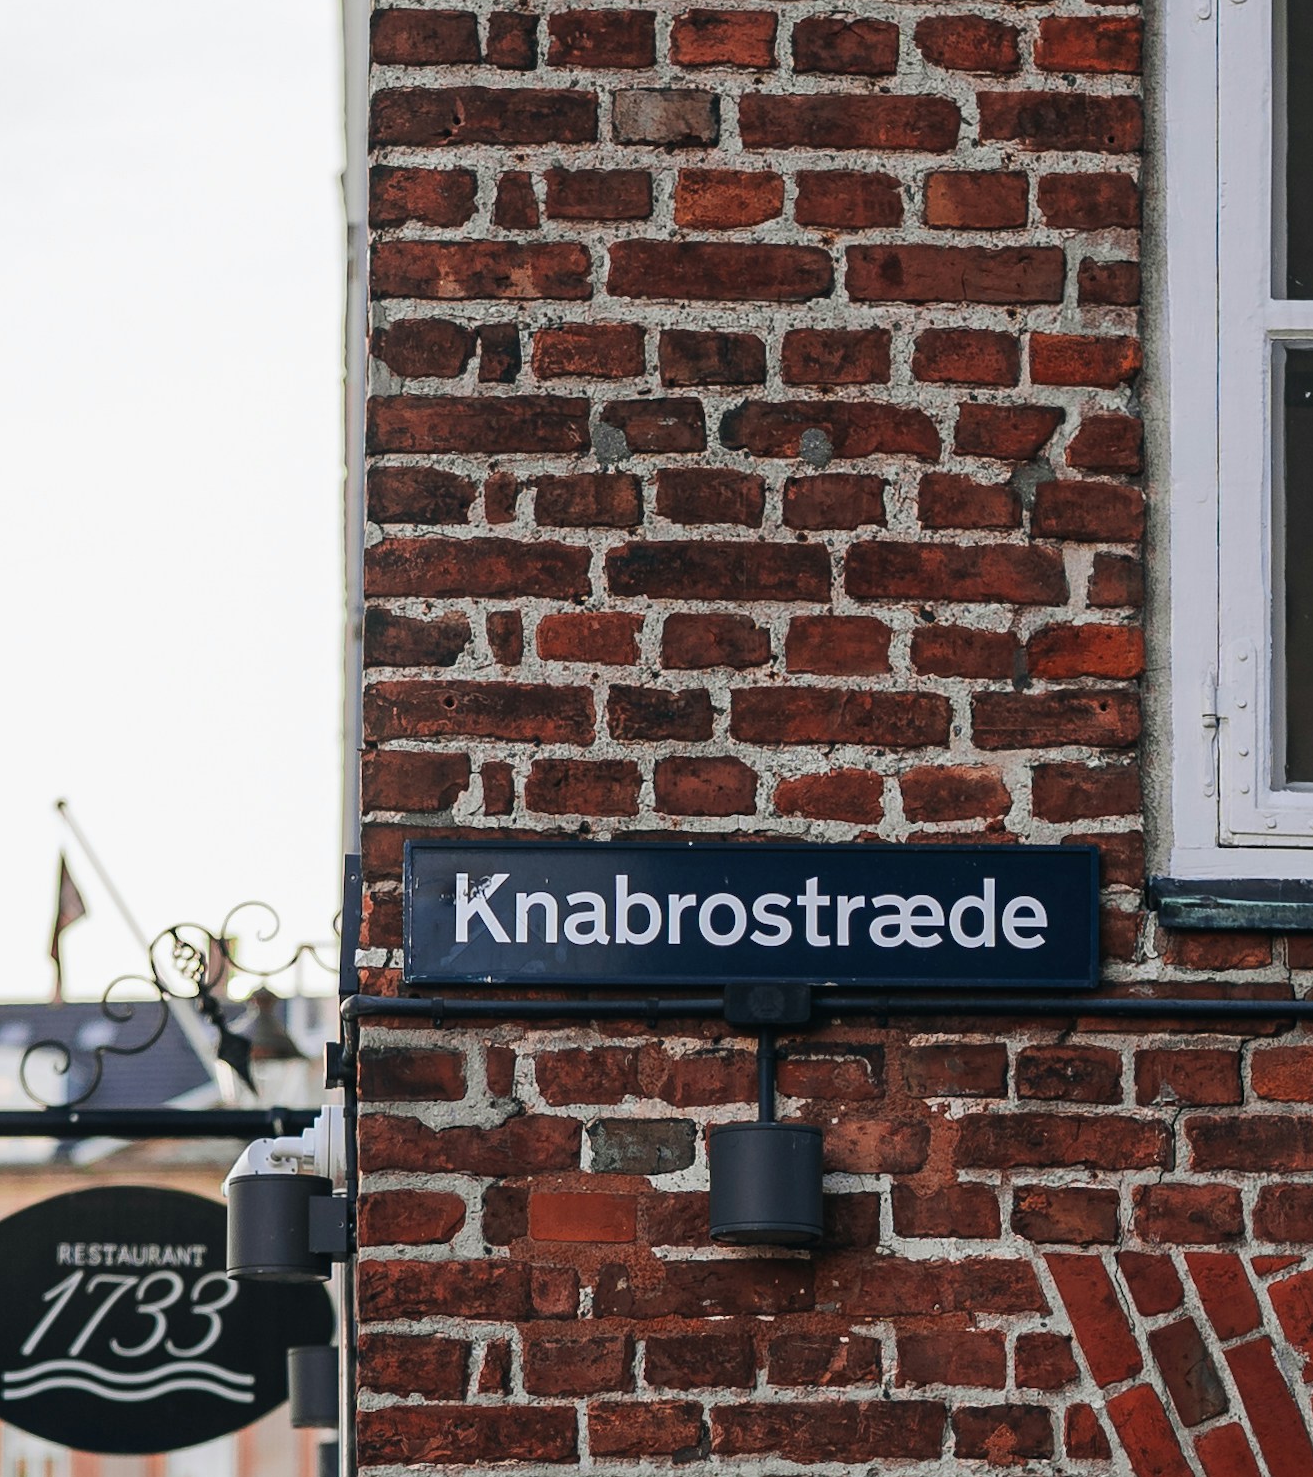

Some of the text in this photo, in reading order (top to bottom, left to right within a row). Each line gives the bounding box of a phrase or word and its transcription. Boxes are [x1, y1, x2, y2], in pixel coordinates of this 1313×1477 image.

[454, 872, 1049, 950] Knabrostræde
[56, 1241, 208, 1268] RESTAURANT
[20, 1269, 240, 1358] 1733
